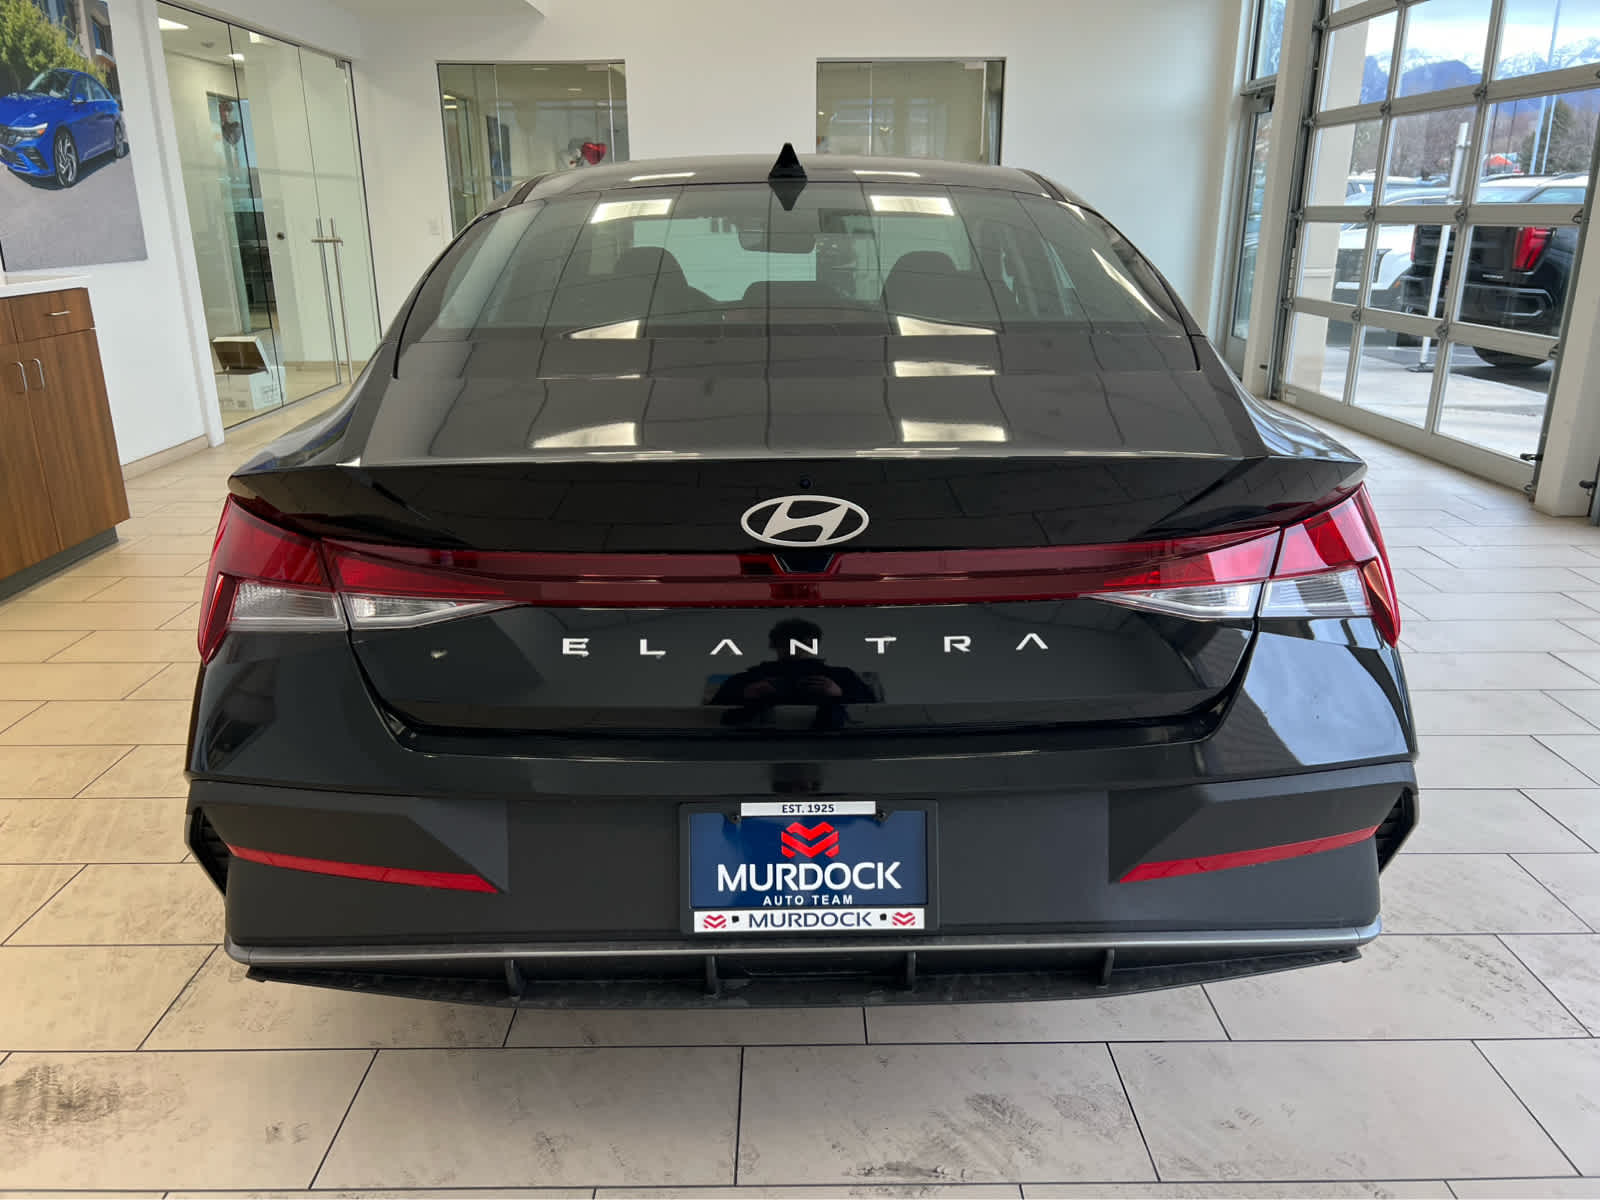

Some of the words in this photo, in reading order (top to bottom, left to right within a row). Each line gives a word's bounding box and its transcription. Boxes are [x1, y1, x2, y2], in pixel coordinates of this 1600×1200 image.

[562, 633, 1048, 656] ELANTRA
[782, 804, 804, 813] EST.
[808, 804, 834, 813] 1925
[717, 862, 902, 892] MURDOCK
[763, 895, 804, 906] AUTO
[812, 894, 853, 905] TEAM
[748, 911, 873, 929] MURDOCK
